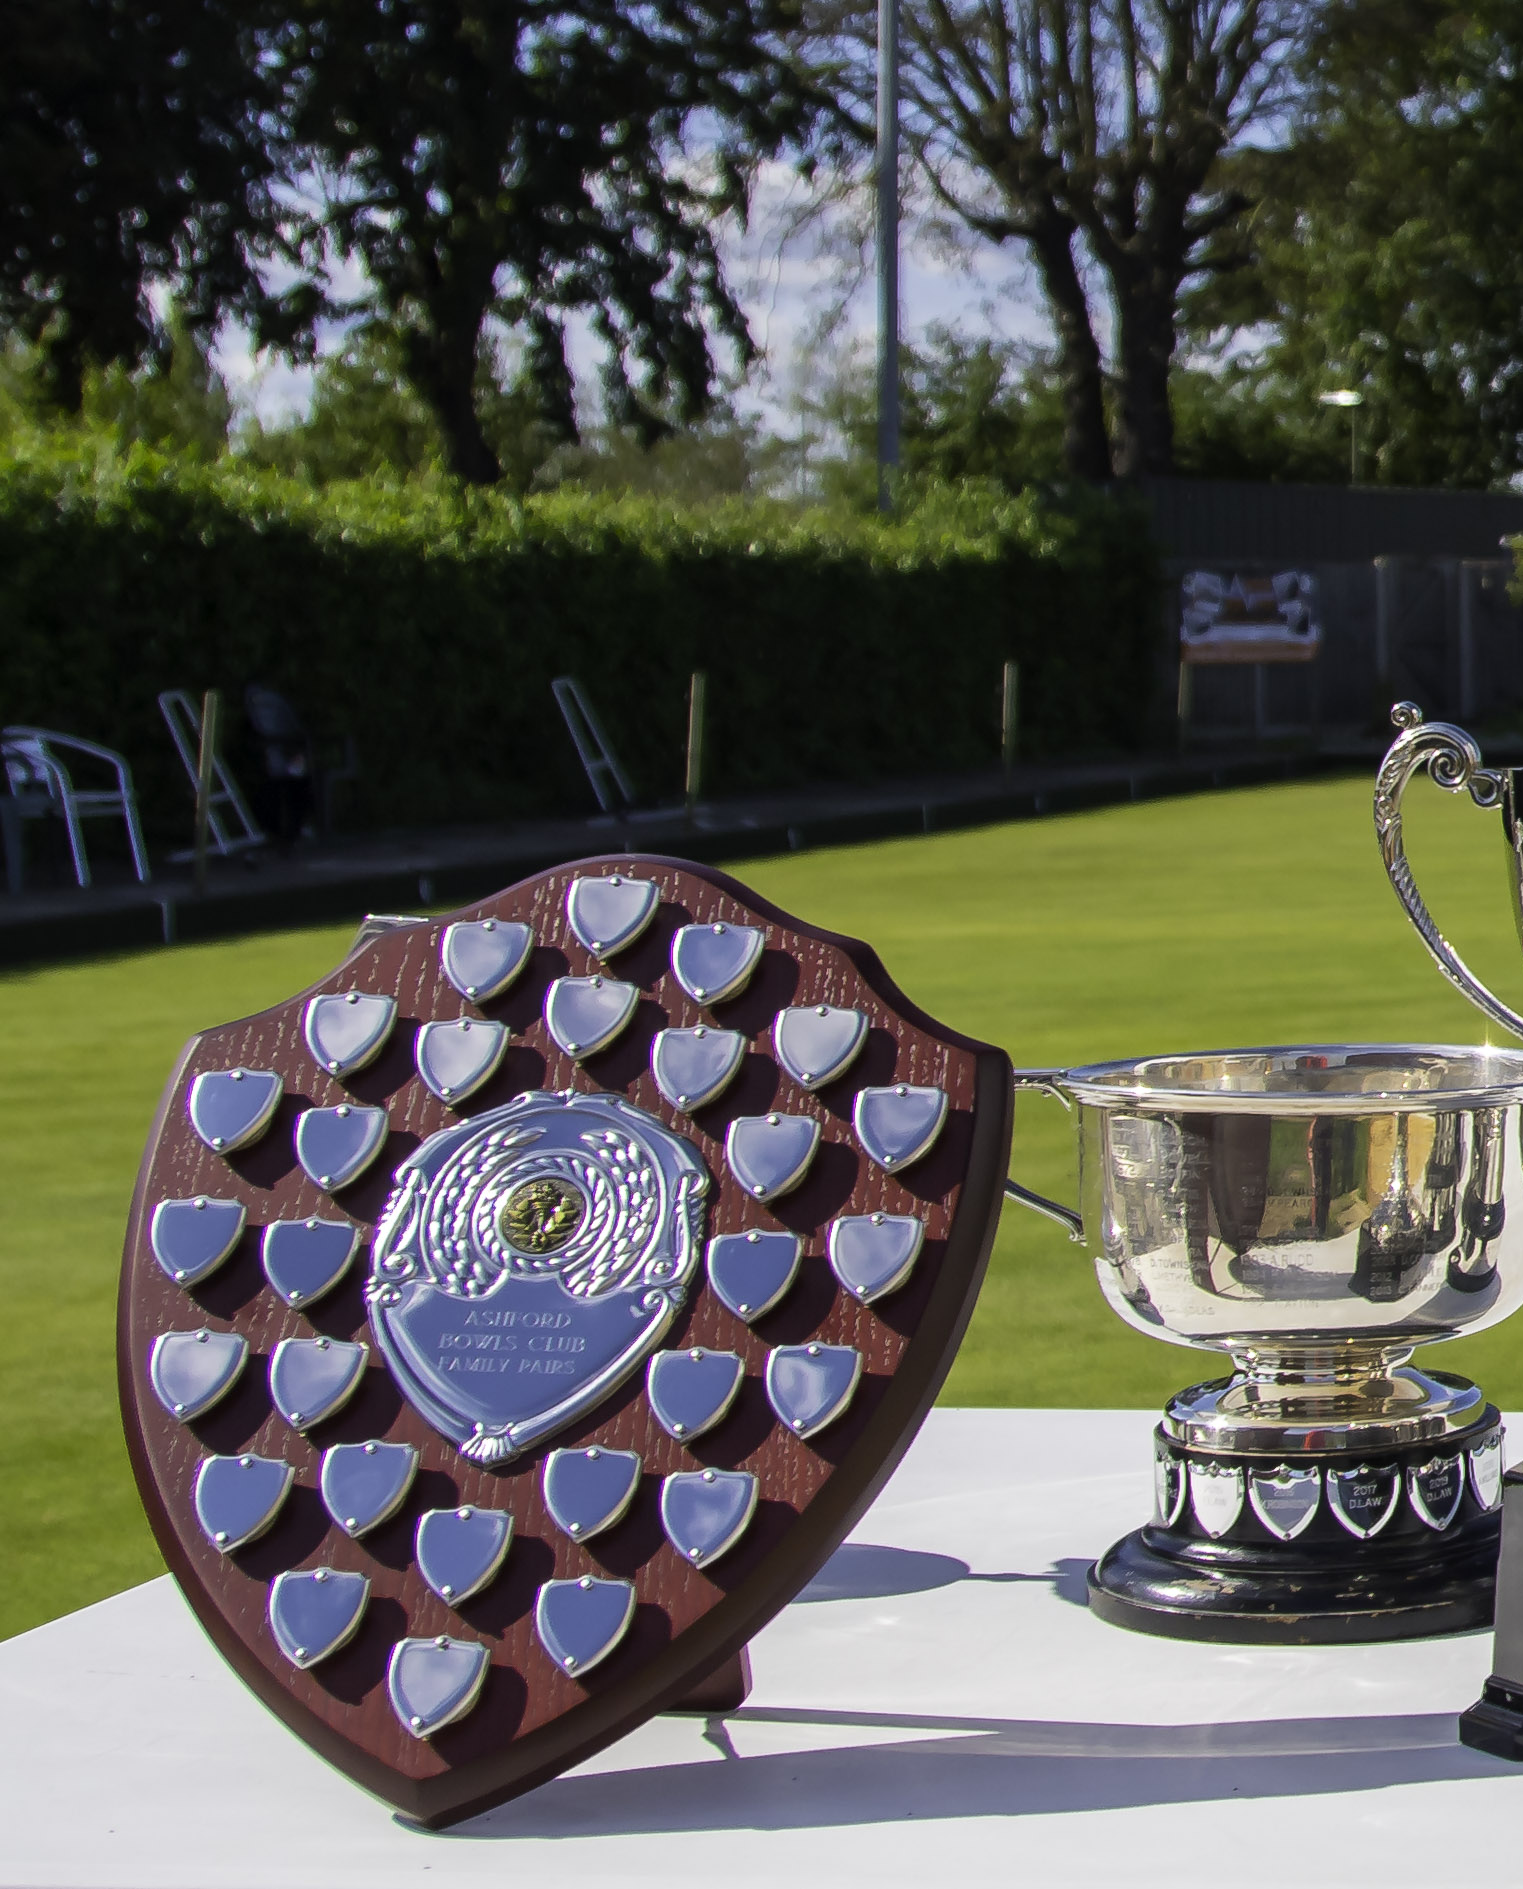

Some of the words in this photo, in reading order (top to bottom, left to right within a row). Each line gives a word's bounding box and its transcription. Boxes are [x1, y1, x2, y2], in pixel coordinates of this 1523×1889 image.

[464, 1310, 572, 1328] ASHFORD
[438, 1333, 518, 1351] BOWLS
[528, 1336, 586, 1353] CLUB
[438, 1356, 511, 1373] FAMILY
[517, 1358, 576, 1375] PAIRS
[1352, 1483, 1378, 1497] 2017
[1349, 1496, 1384, 1510] D.LAW
